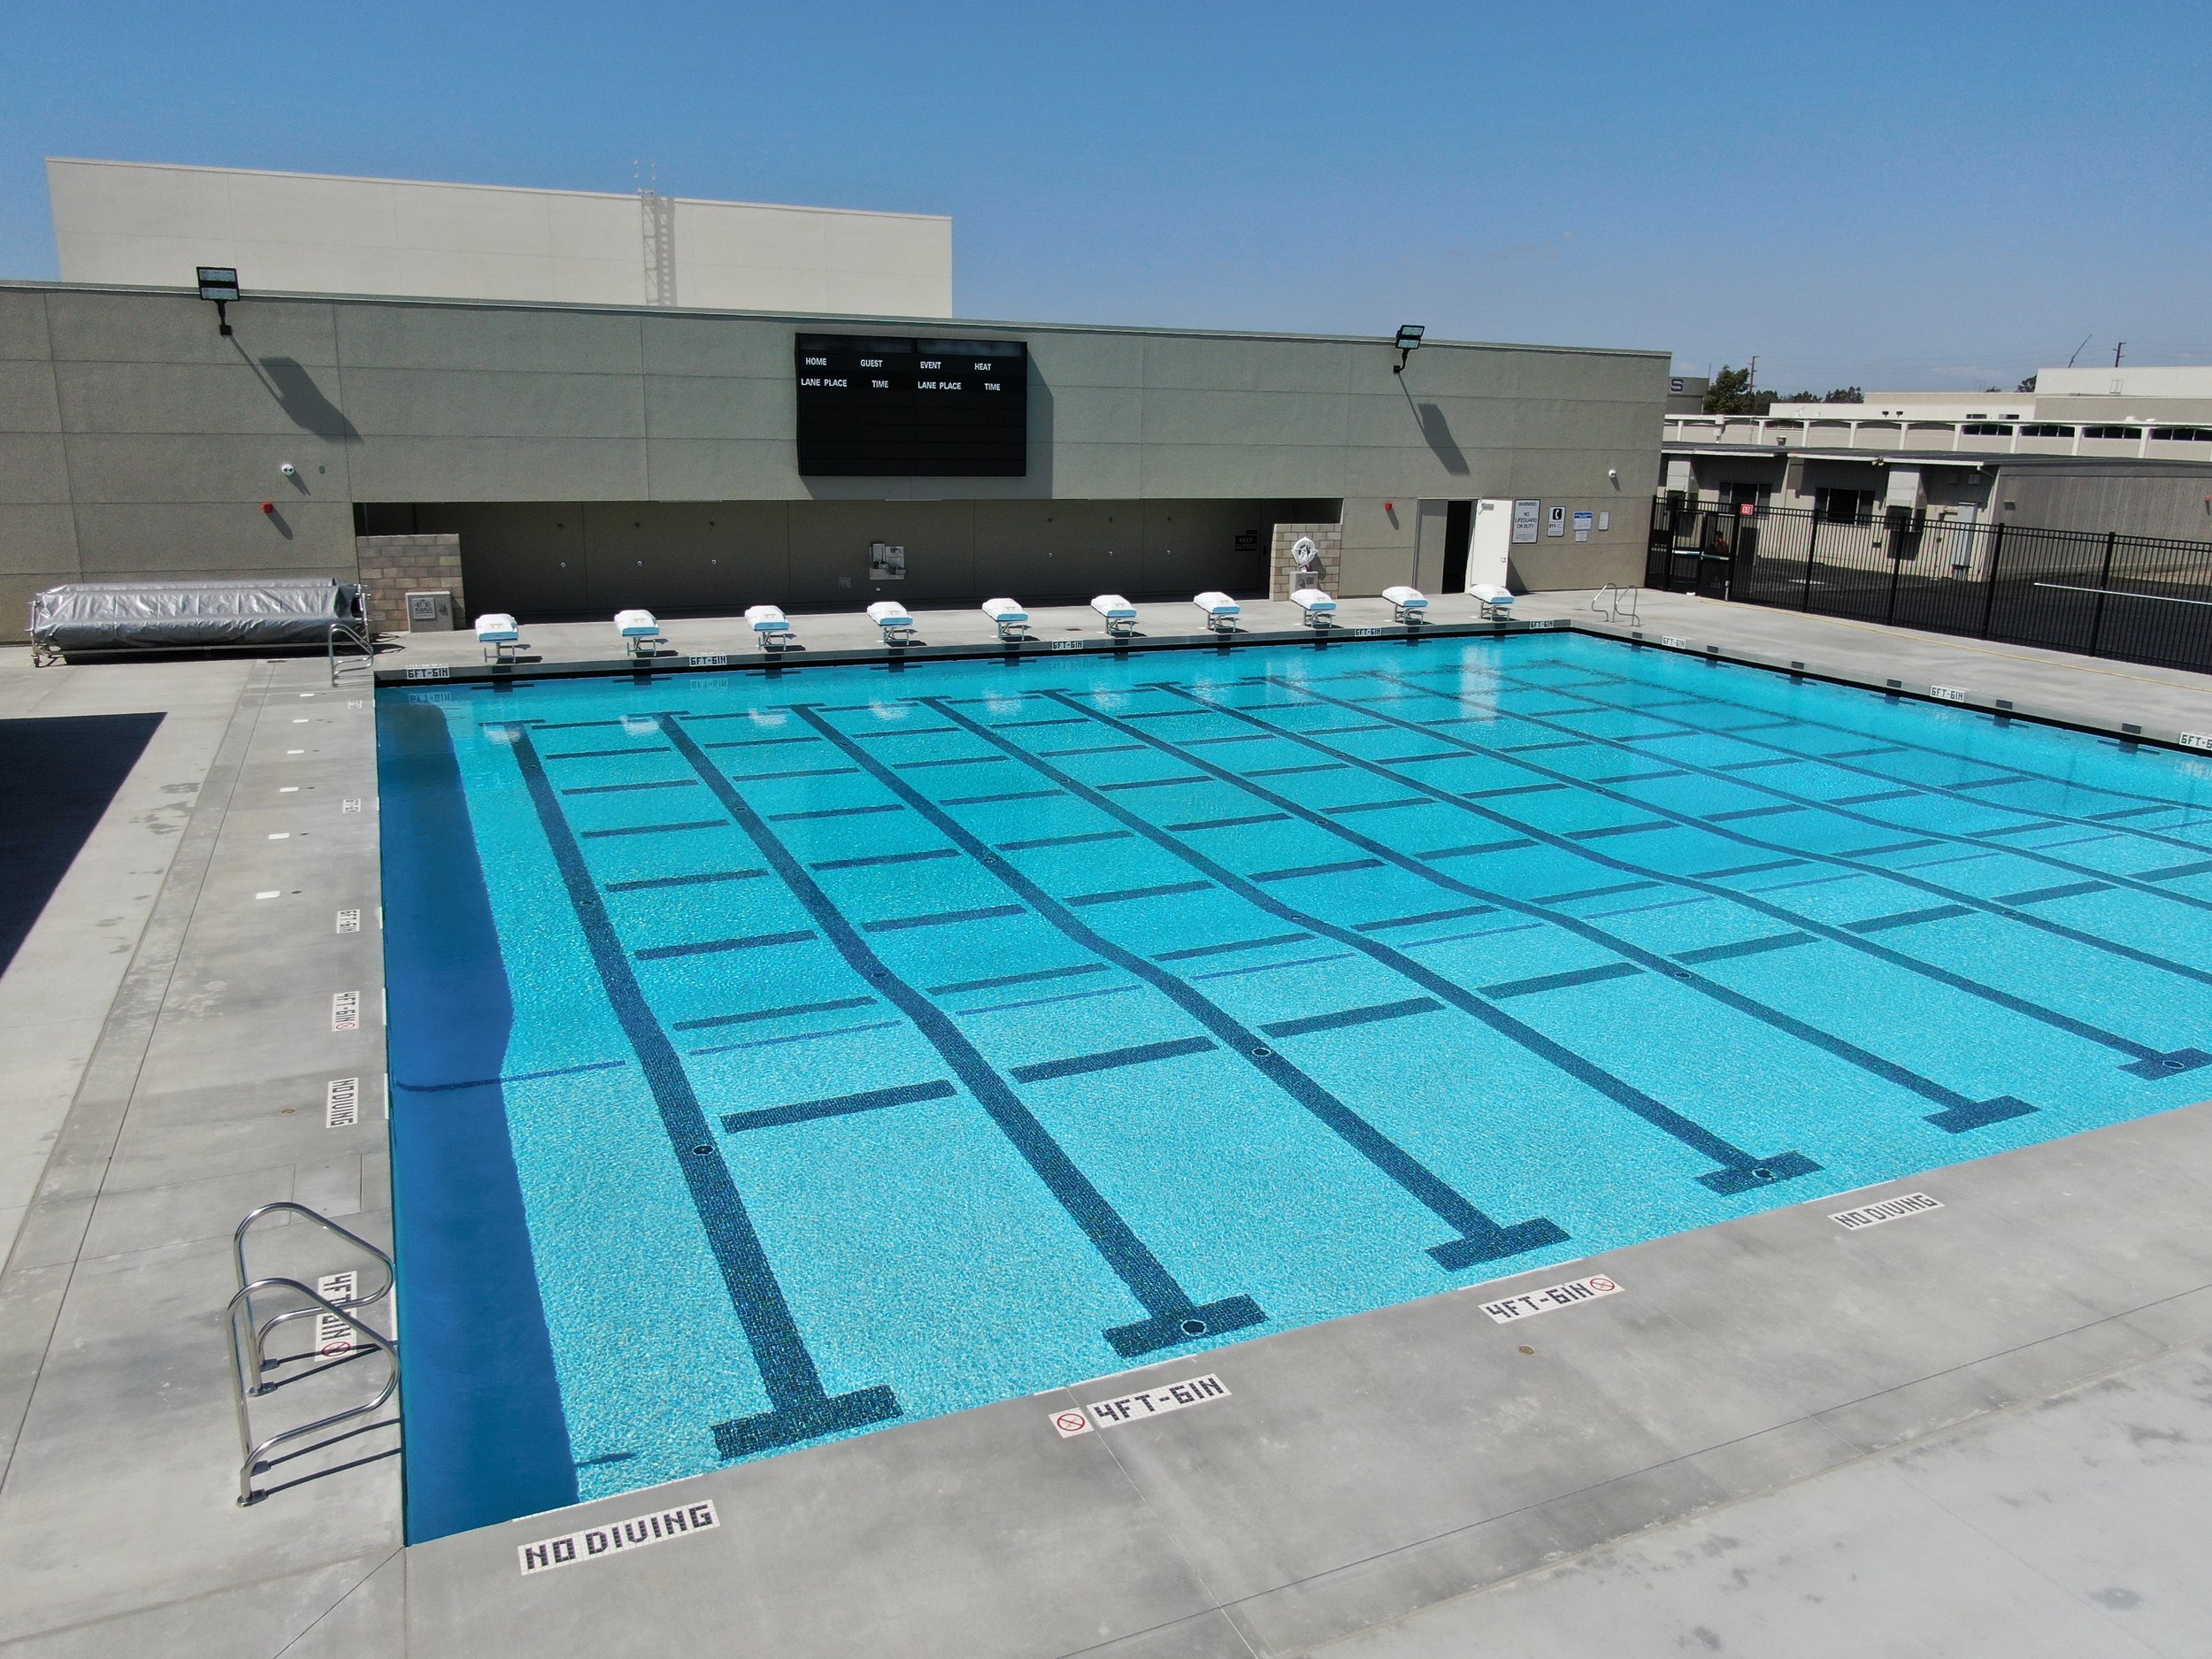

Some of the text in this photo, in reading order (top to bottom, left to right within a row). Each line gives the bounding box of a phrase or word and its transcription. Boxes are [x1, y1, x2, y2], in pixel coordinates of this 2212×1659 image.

[805, 357, 827, 366] HOME
[860, 358, 883, 368] GUEST
[919, 361, 941, 370] EVENT
[801, 378, 848, 388] LANE PLACE
[872, 380, 889, 388] TIME
[918, 380, 962, 390] LANE PLACE
[984, 382, 1001, 391] TIME
[690, 656, 726, 665] 6FT-6IN
[408, 667, 449, 679] 6FT-6IN
[331, 1093, 354, 1126] DIVING
[1834, 1194, 1939, 1228] NO DIVING
[1485, 1282, 1595, 1319] 4FT-6IN
[1094, 1377, 1225, 1423] 4FT-6IN
[525, 1503, 713, 1571] NO DIVING
